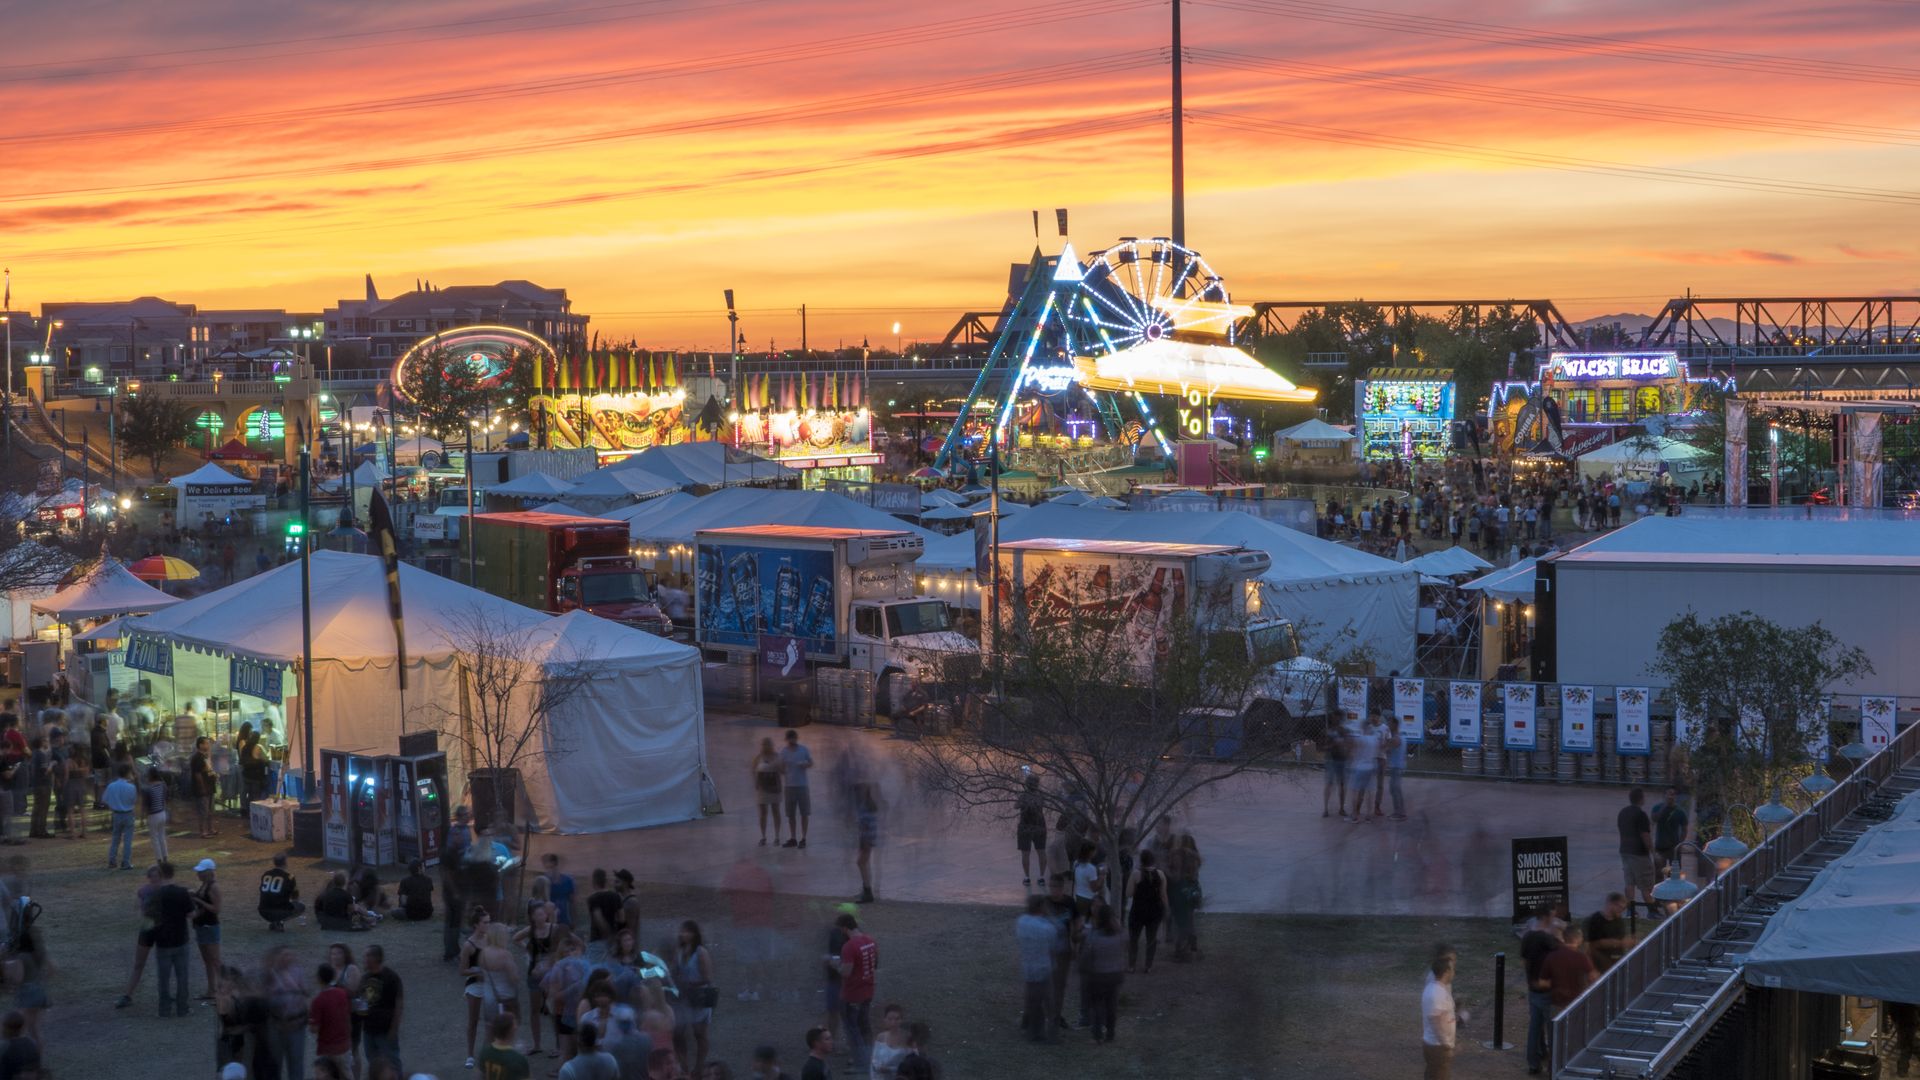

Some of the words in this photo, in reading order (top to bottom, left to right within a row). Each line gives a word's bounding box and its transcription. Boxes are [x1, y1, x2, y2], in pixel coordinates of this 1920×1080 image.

[1562, 359, 1617, 376] WACKY
[1622, 358, 1669, 375] SHACK
[1514, 413, 1535, 444] COHIBA
[187, 486, 201, 494] We
[203, 486, 231, 494] Deliver
[415, 521, 442, 529] LANDINGS
[235, 663, 264, 694] FOOD
[330, 756, 342, 812] ATM
[398, 763, 412, 817] ATM
[1517, 852, 1562, 869] SMOKERS
[261, 875, 284, 893] 90
[1517, 868, 1563, 885] WELCOME
